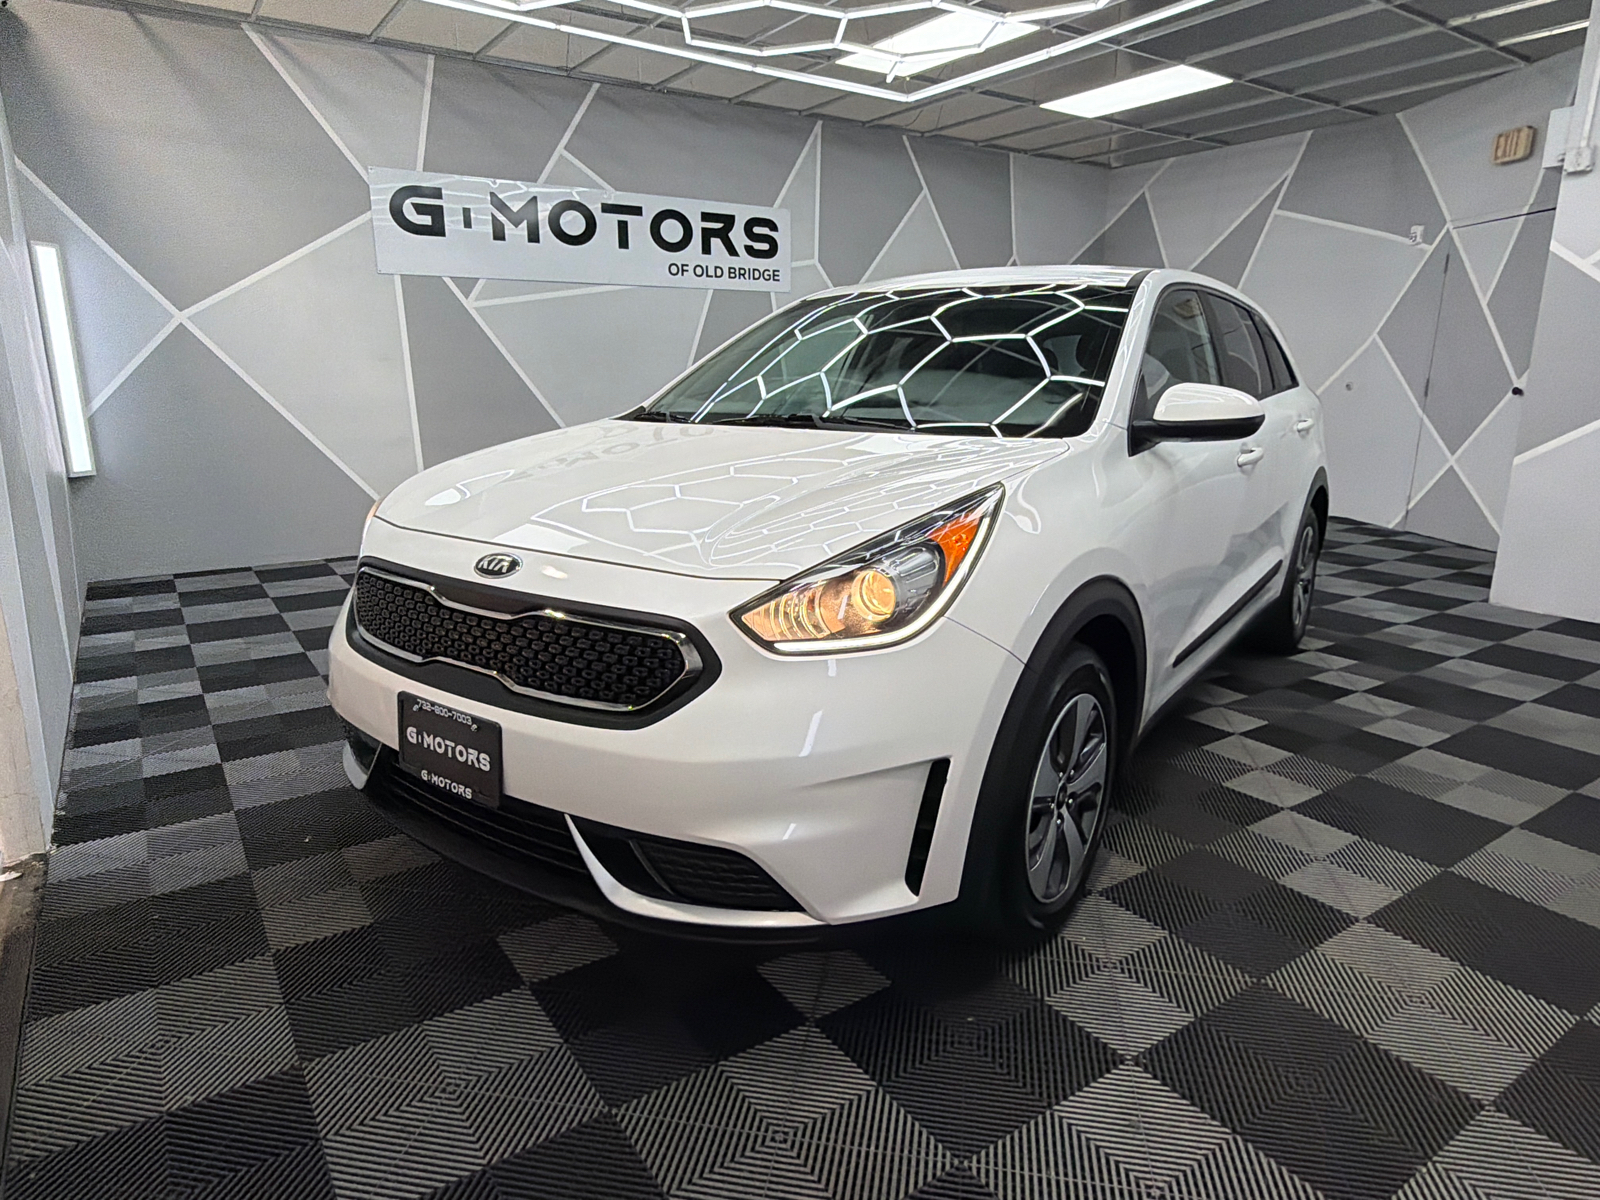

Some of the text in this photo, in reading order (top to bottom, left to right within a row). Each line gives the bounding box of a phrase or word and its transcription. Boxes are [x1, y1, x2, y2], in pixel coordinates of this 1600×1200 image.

[668, 263, 780, 281] OF OLD BRIDGE
[478, 555, 513, 573] KIA
